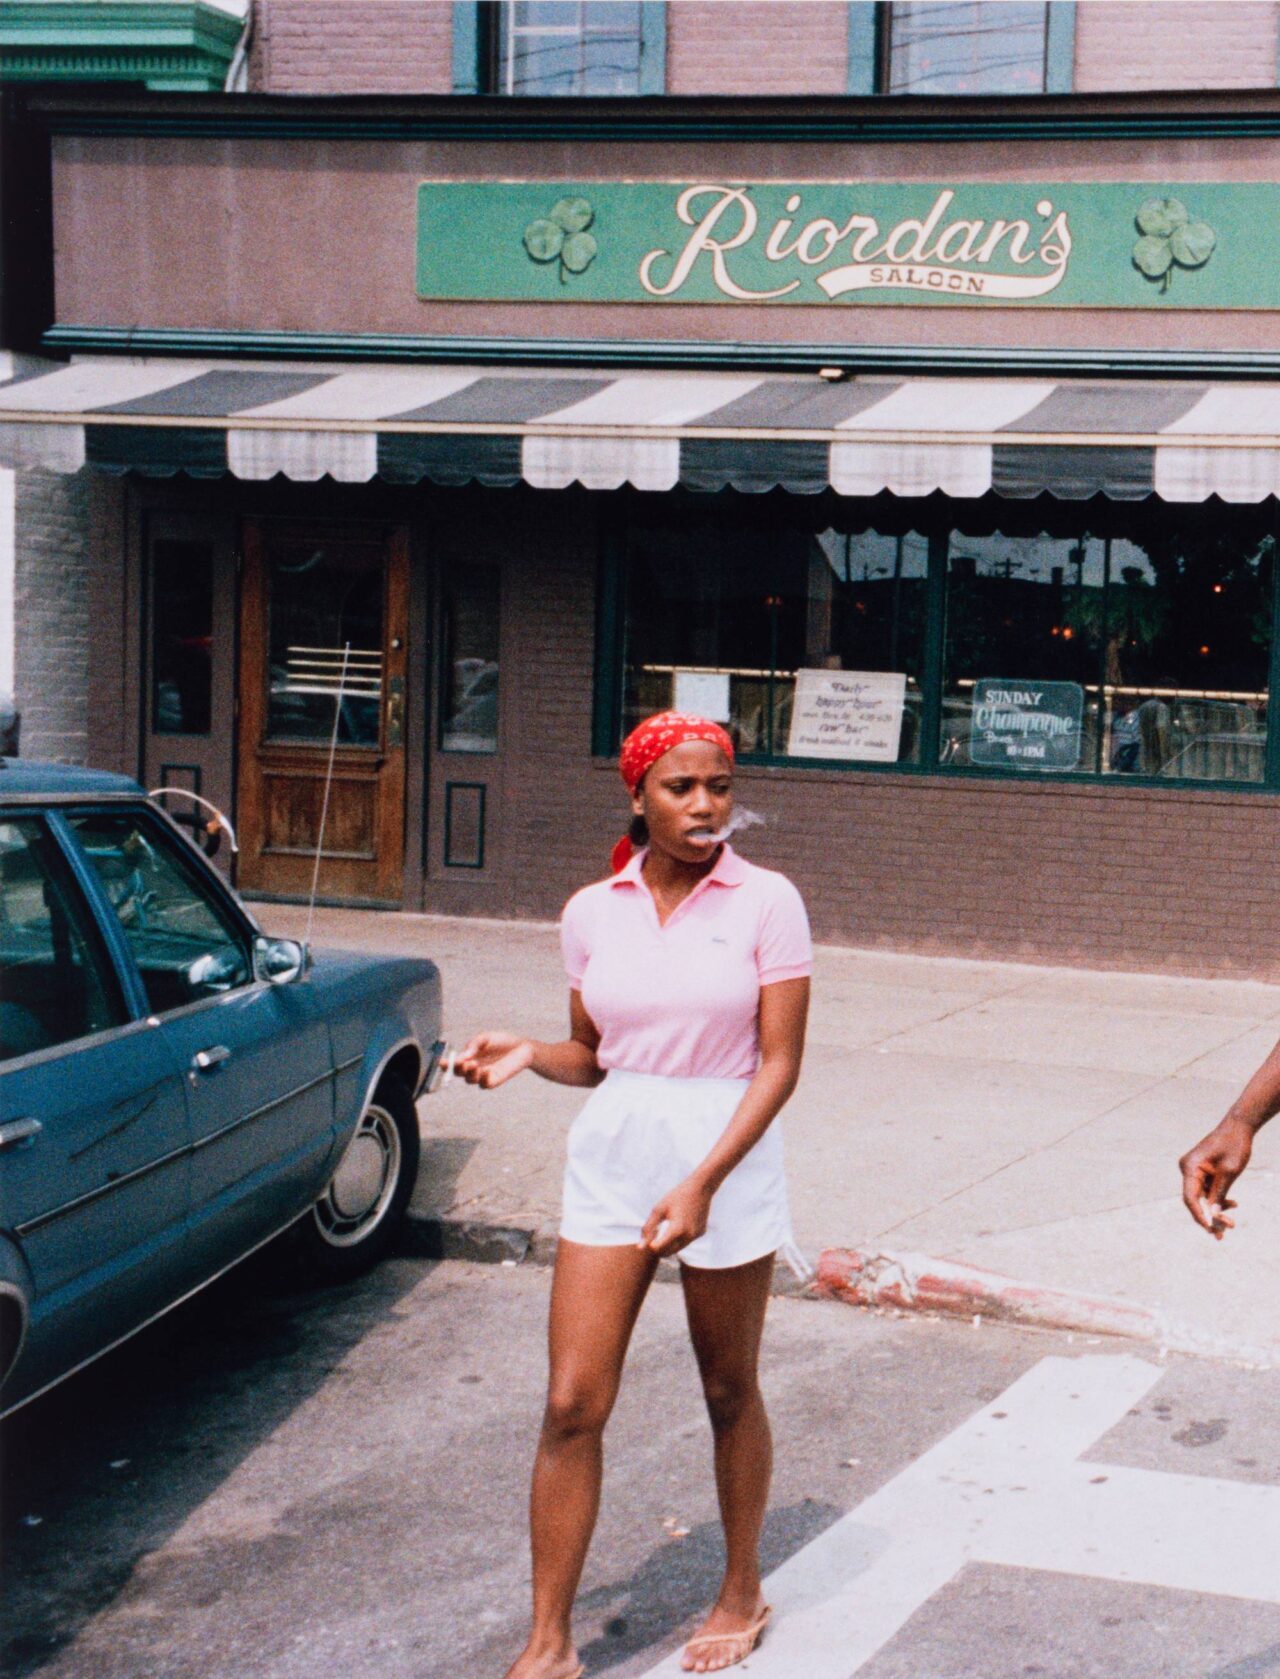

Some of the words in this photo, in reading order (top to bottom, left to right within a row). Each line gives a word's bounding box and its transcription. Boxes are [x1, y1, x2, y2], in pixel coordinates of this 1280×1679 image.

[638, 184, 1072, 300] Riordan's
[869, 267, 985, 292] SALOON
[985, 690, 1043, 706] SUNDAY
[976, 705, 1074, 739] Champagne
